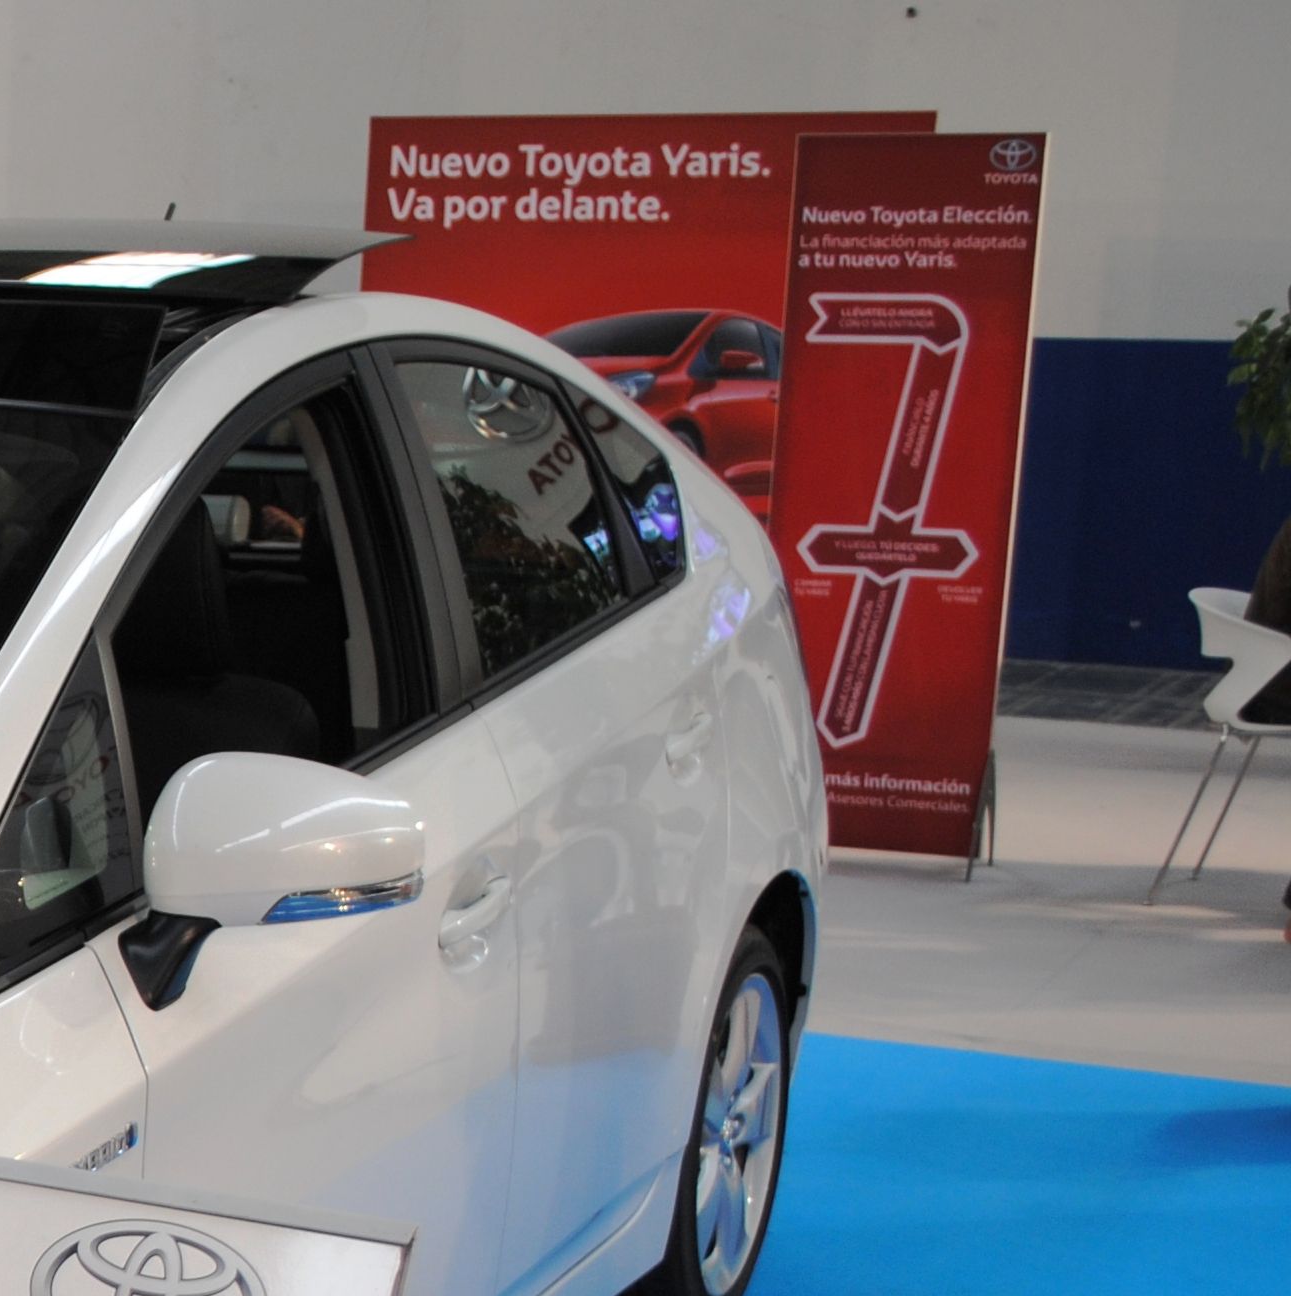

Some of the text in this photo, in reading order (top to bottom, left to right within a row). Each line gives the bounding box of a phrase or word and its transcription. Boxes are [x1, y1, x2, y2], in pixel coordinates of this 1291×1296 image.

[390, 143, 770, 186] Nuevo Toyota Yaris.
[984, 173, 1038, 185] TOYOTA
[387, 187, 670, 228] Va por delante.
[802, 206, 865, 223] Nuevo
[870, 206, 937, 228] Toyota
[799, 234, 1027, 252] La financiación más adaptada
[798, 255, 809, 267] a
[814, 253, 834, 267] tu
[838, 254, 900, 268] nuevo
[825, 772, 970, 795] más información
